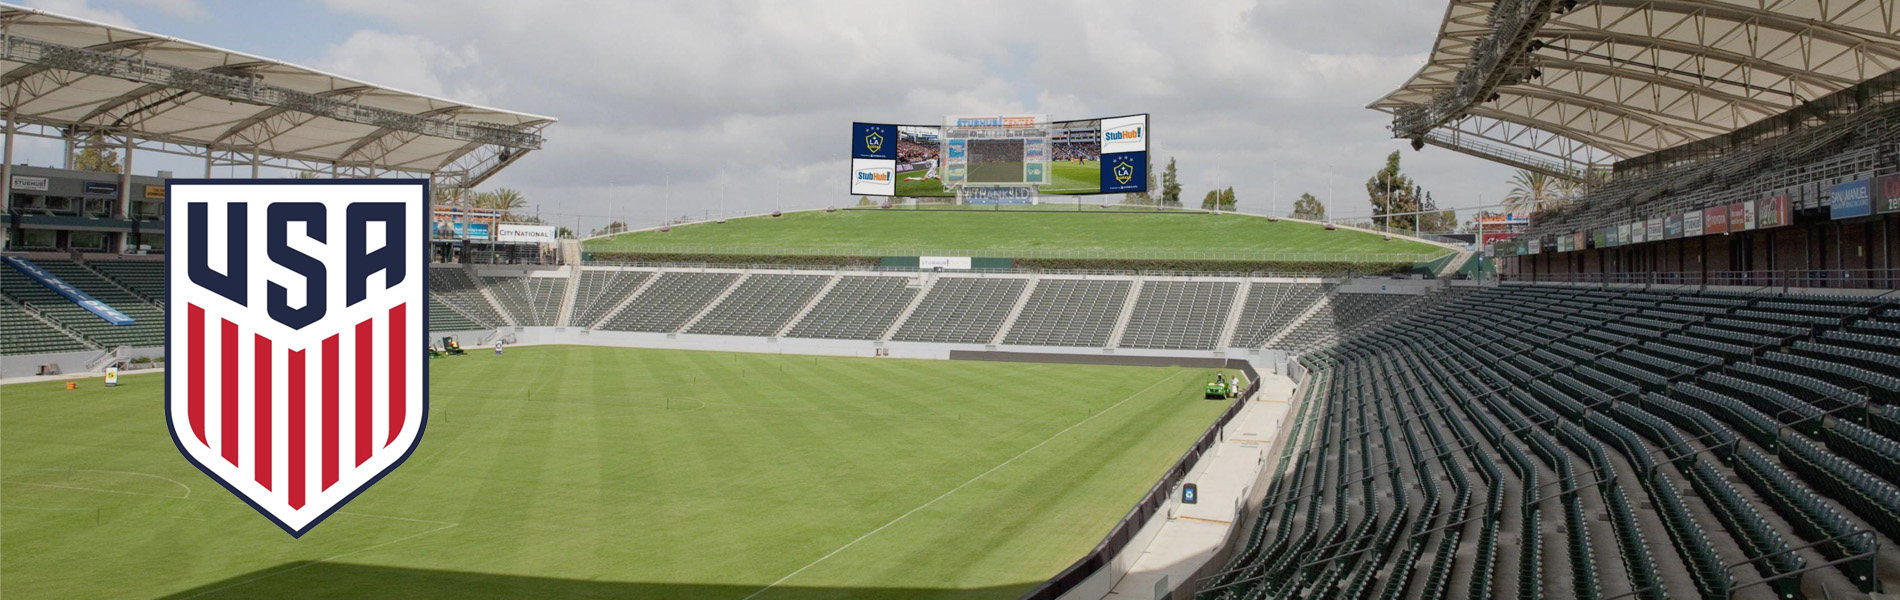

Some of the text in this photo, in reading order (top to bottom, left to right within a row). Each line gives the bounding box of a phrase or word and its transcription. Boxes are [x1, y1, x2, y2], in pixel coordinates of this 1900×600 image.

[1105, 126, 1142, 141] StubHub!
[858, 171, 891, 182] StubHub!
[499, 229, 549, 238] CITY NATIONAL
